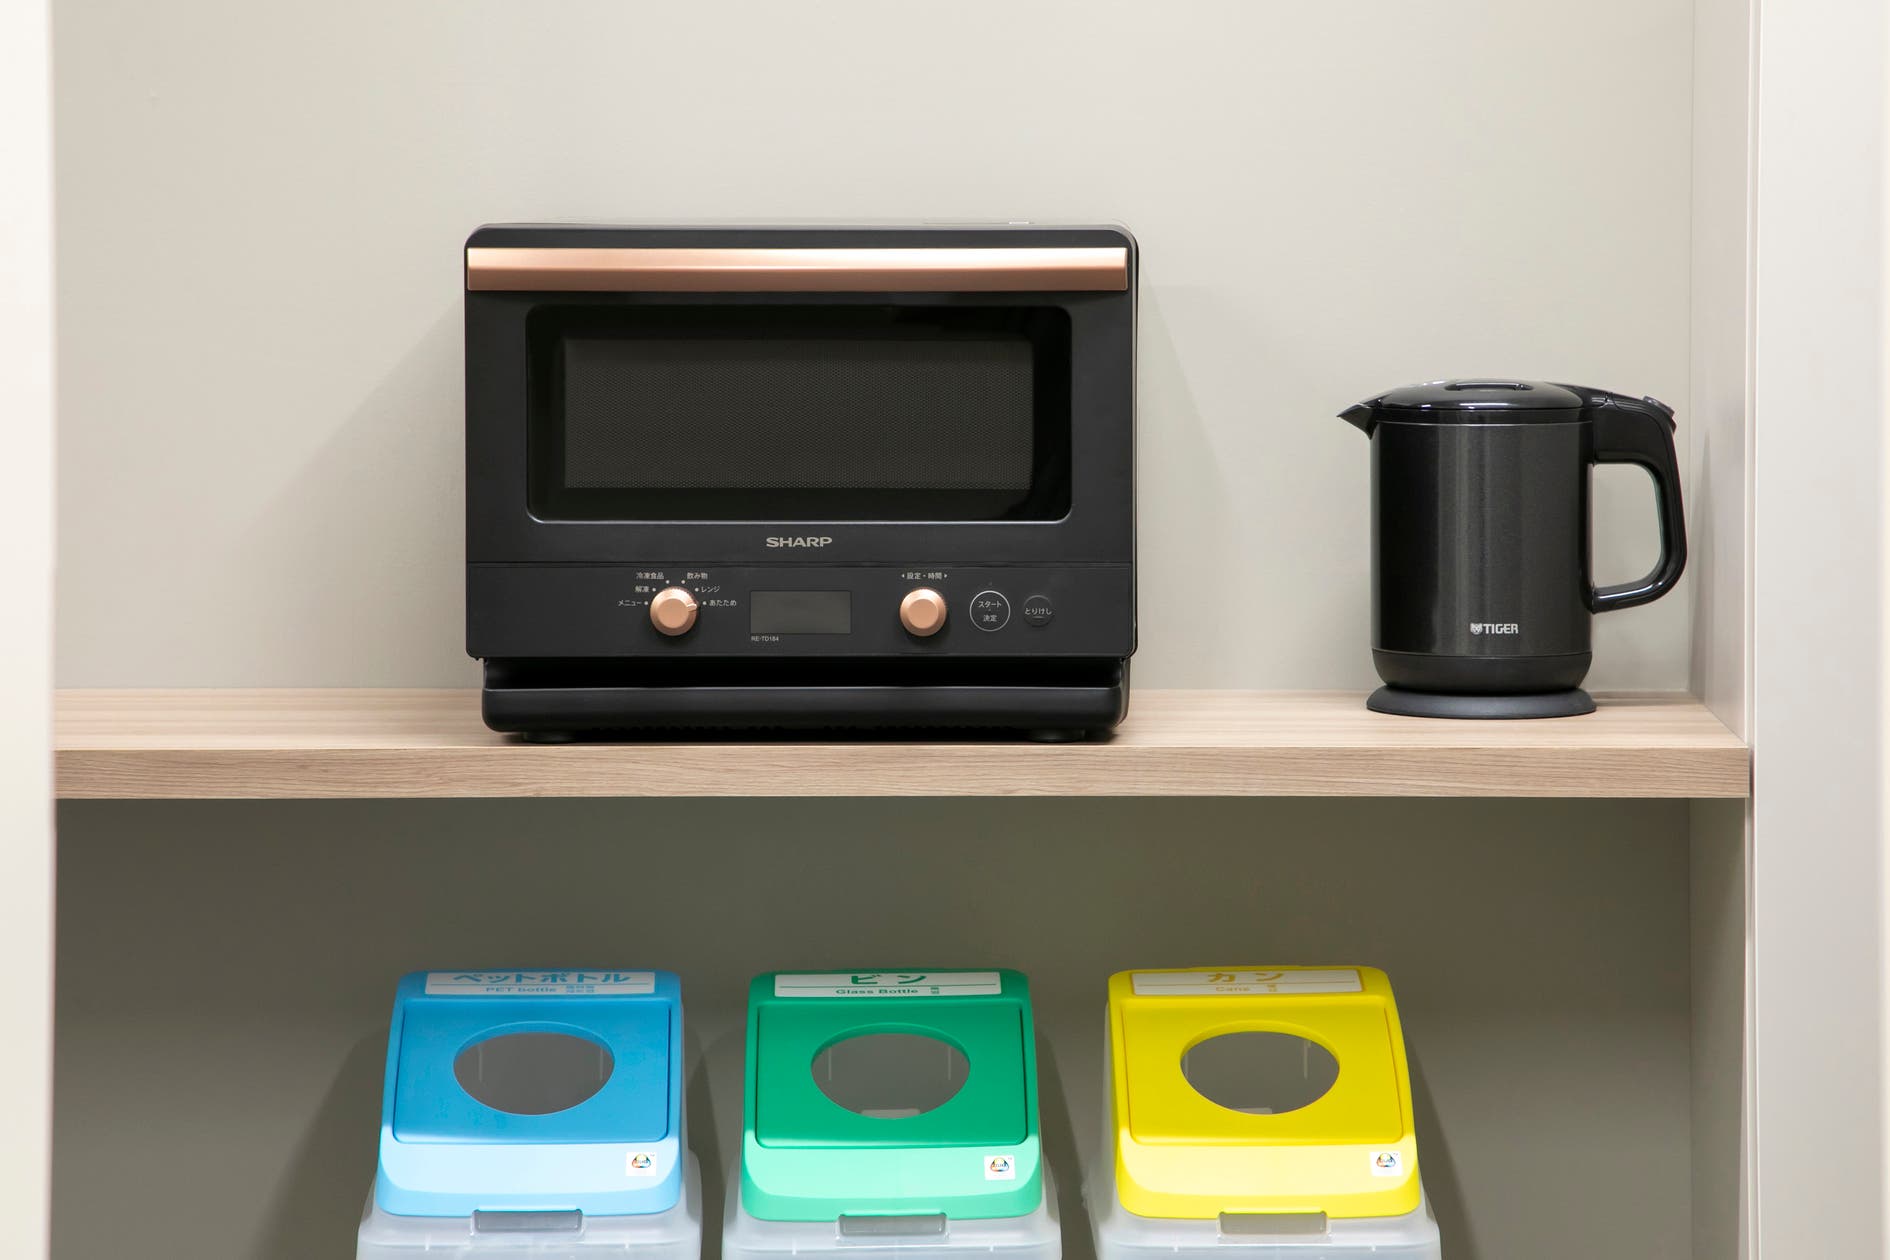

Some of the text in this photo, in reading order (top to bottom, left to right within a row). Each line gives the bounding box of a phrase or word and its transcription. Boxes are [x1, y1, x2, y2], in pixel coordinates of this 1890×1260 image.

[766, 537, 833, 548] SHARP
[686, 572, 709, 580] 飲み物
[701, 585, 721, 593] レンジ
[978, 600, 1002, 608] スタート
[1024, 607, 1053, 616] とりけし
[983, 614, 998, 622] 決定
[1482, 623, 1519, 635] TIGER
[851, 974, 927, 985] ビン
[1207, 972, 1284, 983] カン
